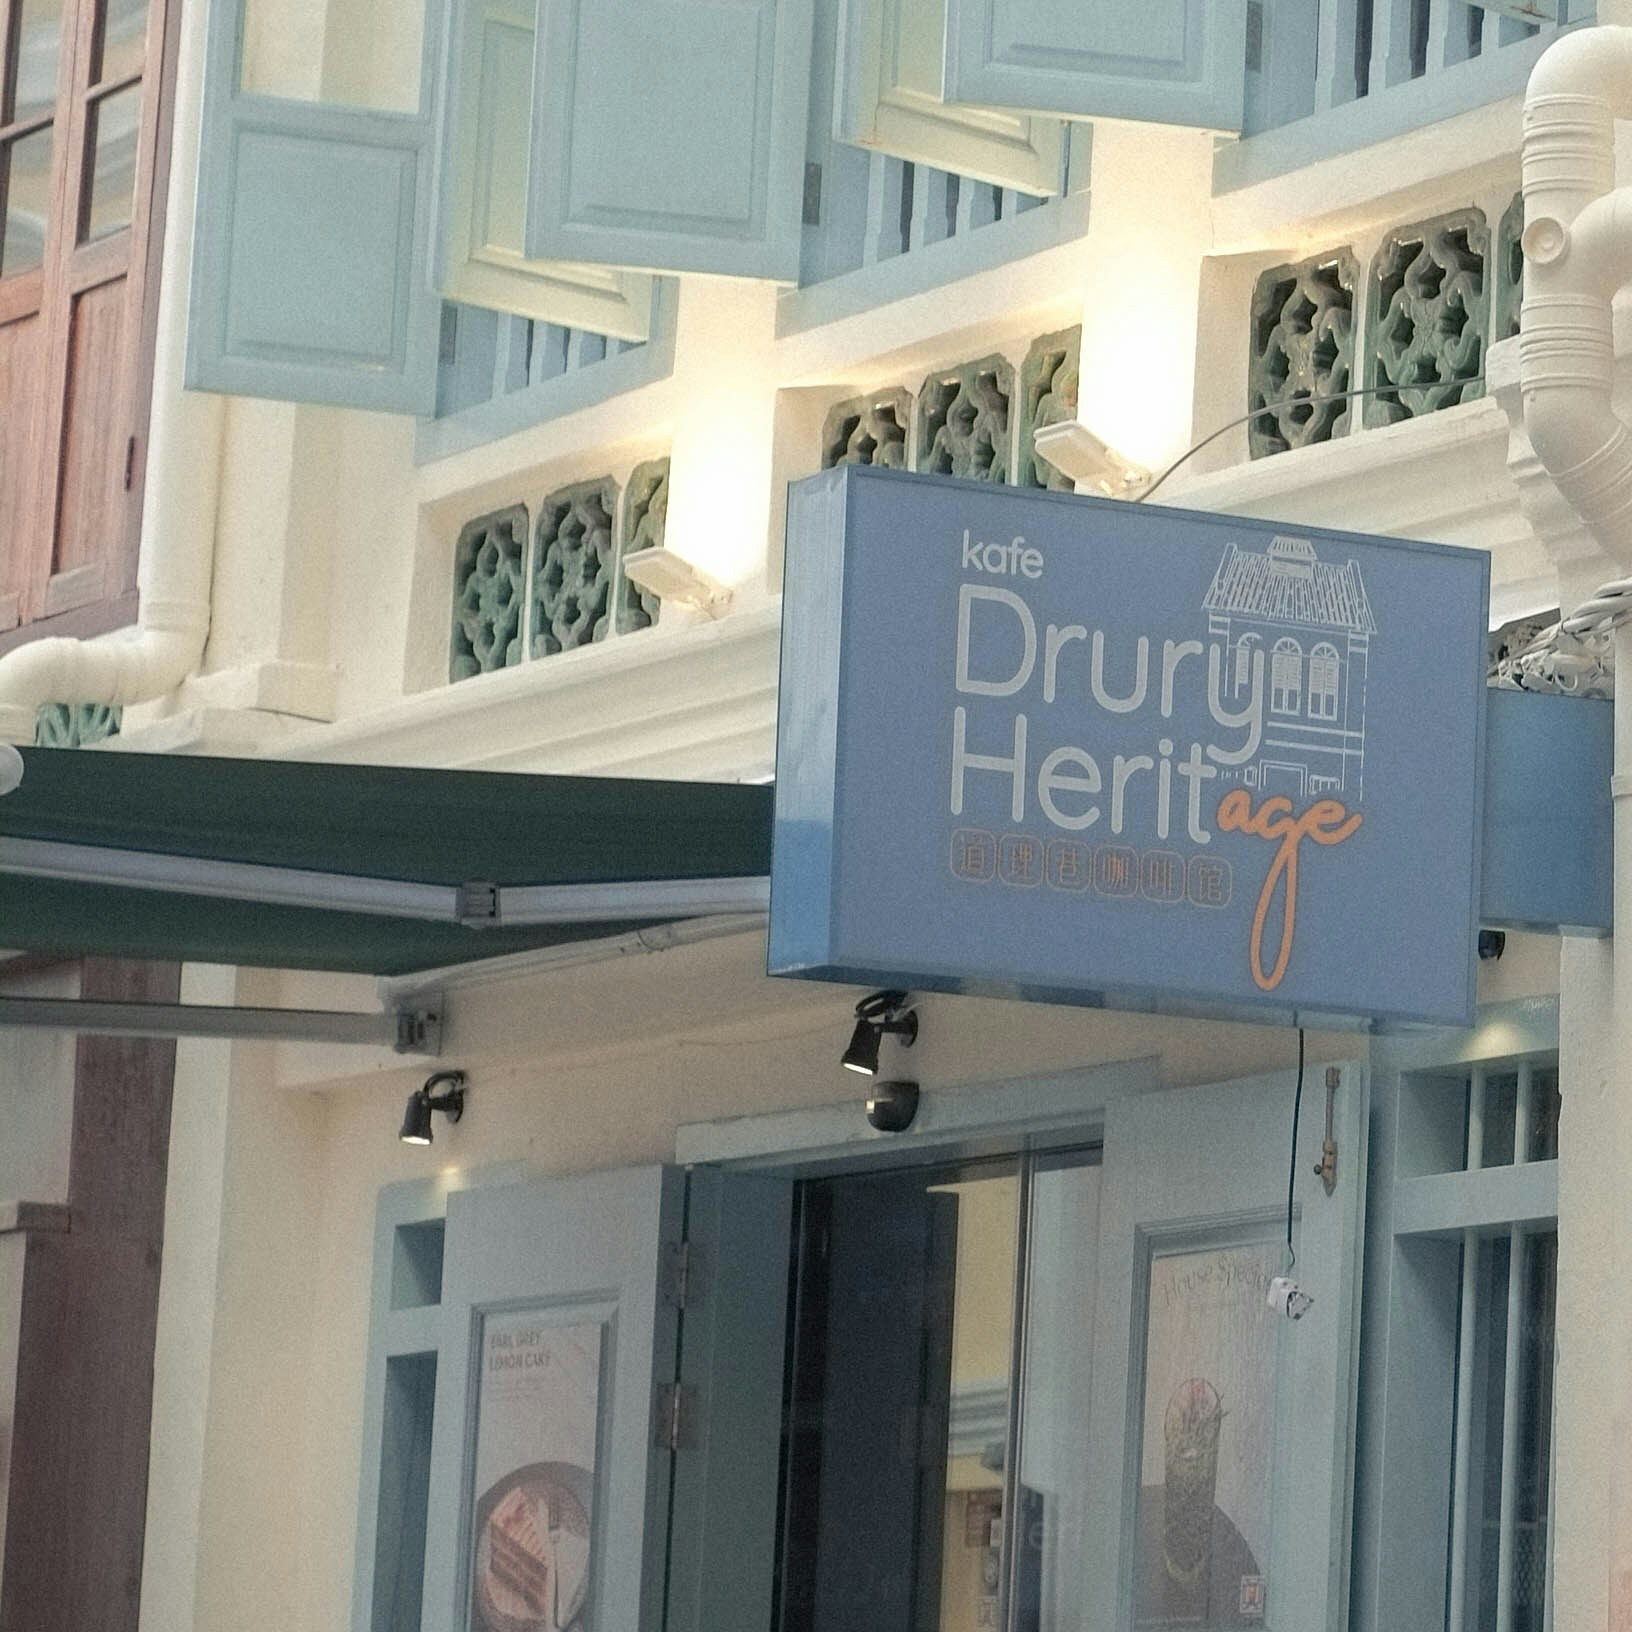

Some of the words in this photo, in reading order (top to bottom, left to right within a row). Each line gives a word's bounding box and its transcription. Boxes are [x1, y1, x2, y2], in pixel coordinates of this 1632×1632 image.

[962, 529, 1045, 579] kafe
[955, 583, 1265, 765] Drury
[950, 705, 1364, 992] Heritage
